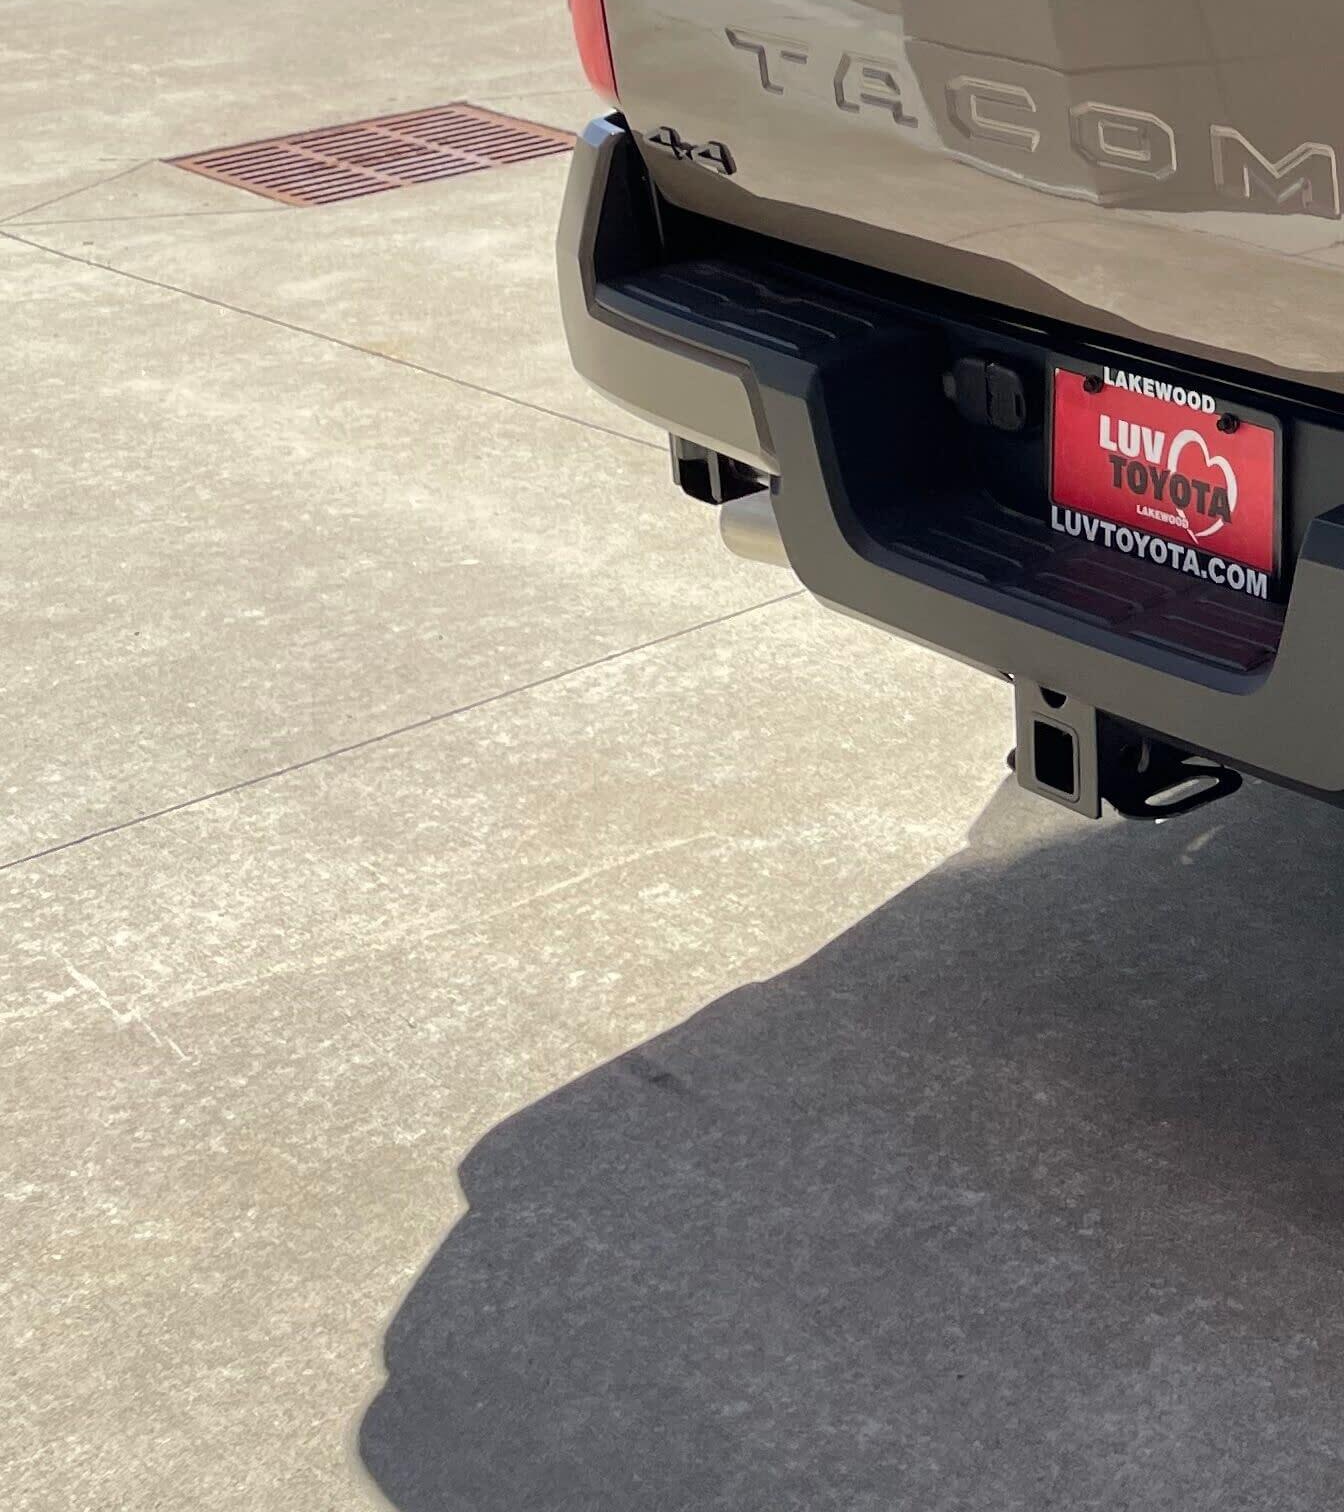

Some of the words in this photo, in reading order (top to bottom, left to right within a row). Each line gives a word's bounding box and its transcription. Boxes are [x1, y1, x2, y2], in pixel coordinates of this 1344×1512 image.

[1103, 366, 1216, 415] LAKEWOOD
[1099, 414, 1166, 465] LUV
[1109, 454, 1232, 524] TOYOTA
[1136, 504, 1190, 530] LAKEWOOD
[1051, 504, 1268, 600] LUVTOYOTA.COM
